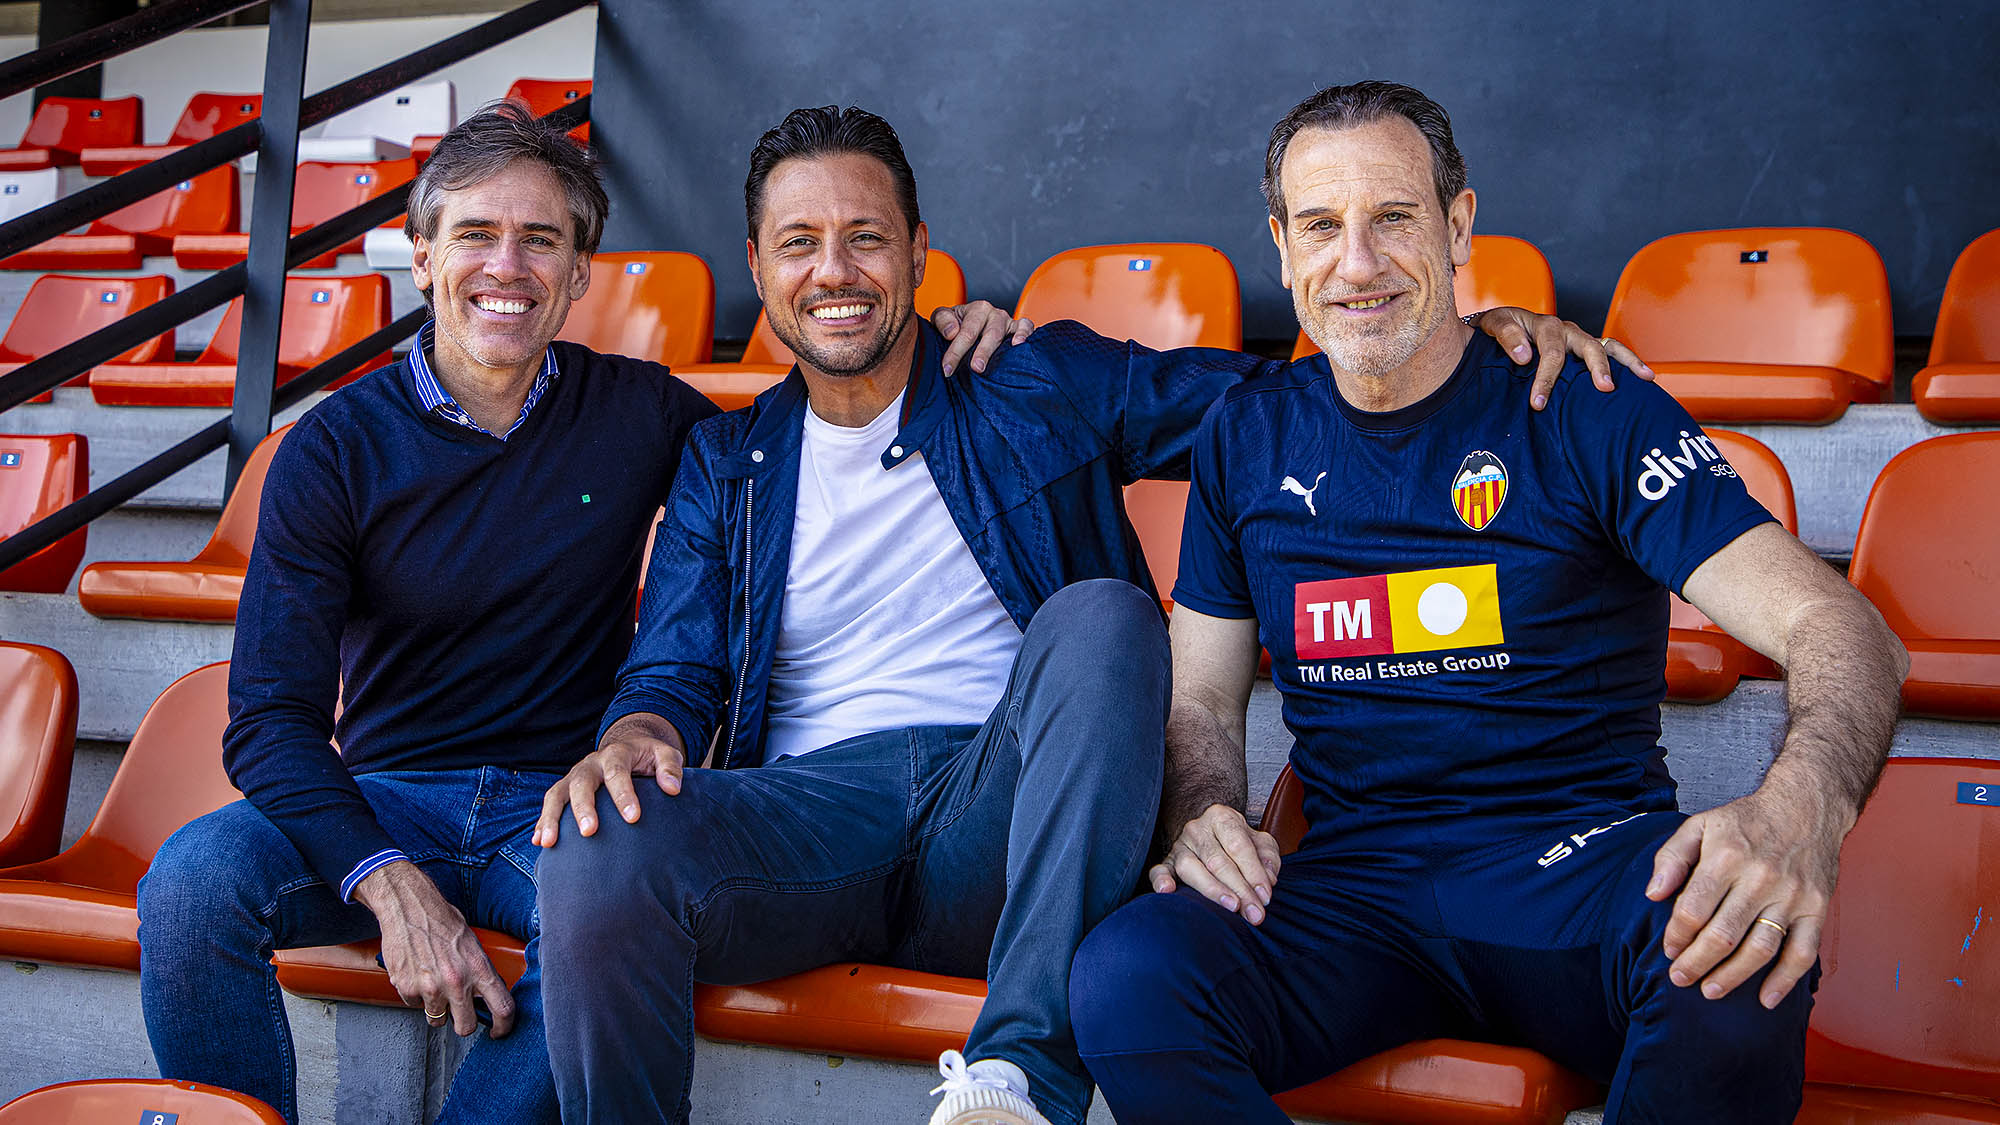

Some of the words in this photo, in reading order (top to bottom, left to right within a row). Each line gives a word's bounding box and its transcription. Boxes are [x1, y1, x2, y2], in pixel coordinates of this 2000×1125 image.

[6, 454, 15, 465] 2
[1306, 598, 1373, 642] TM
[1298, 665, 1325, 683] TM
[1331, 662, 1372, 682] Real
[1377, 659, 1438, 679] Estate
[1442, 652, 1512, 672] Group
[1975, 786, 1987, 801] 2
[1537, 812, 1648, 869] SK
